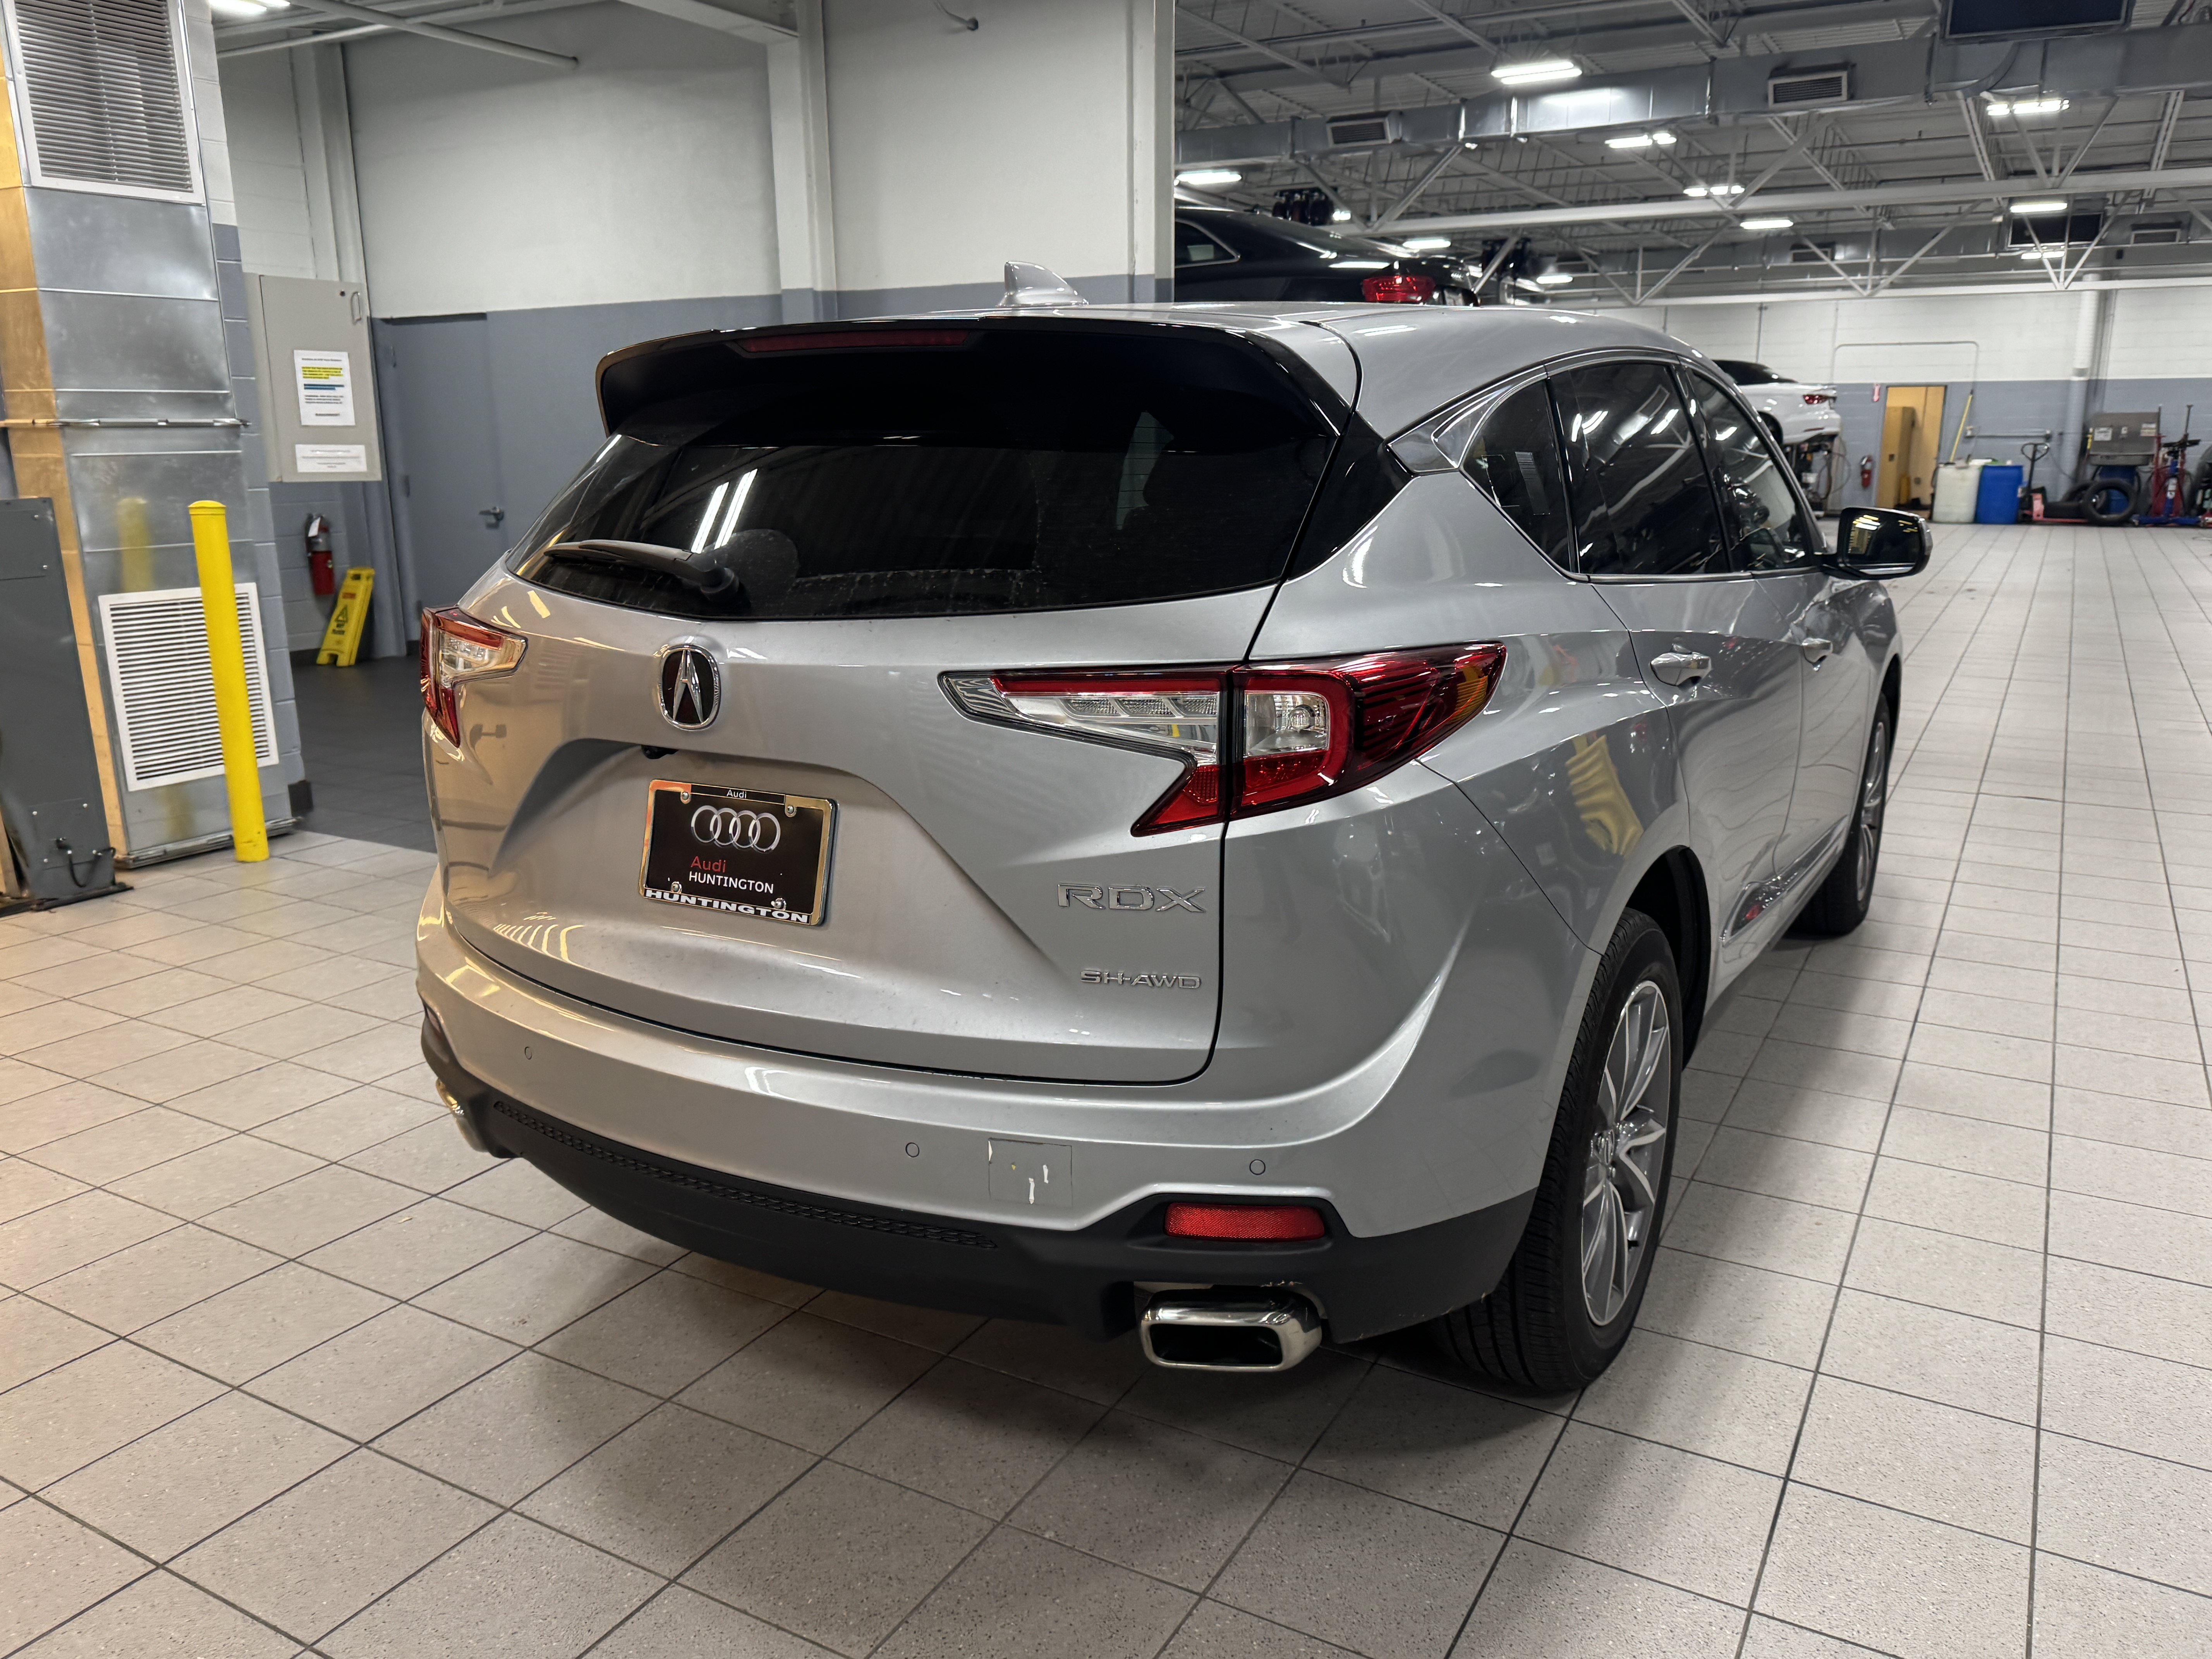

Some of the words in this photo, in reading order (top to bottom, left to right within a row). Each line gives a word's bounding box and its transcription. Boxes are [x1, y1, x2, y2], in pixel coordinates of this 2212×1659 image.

[726, 789, 747, 799] Audi
[690, 856, 726, 872] Audi
[689, 871, 773, 893] HUNTINGTON
[646, 890, 808, 923] HUNTINGTON
[1058, 883, 1206, 912] RDX
[1081, 970, 1201, 989] SH-AWD
